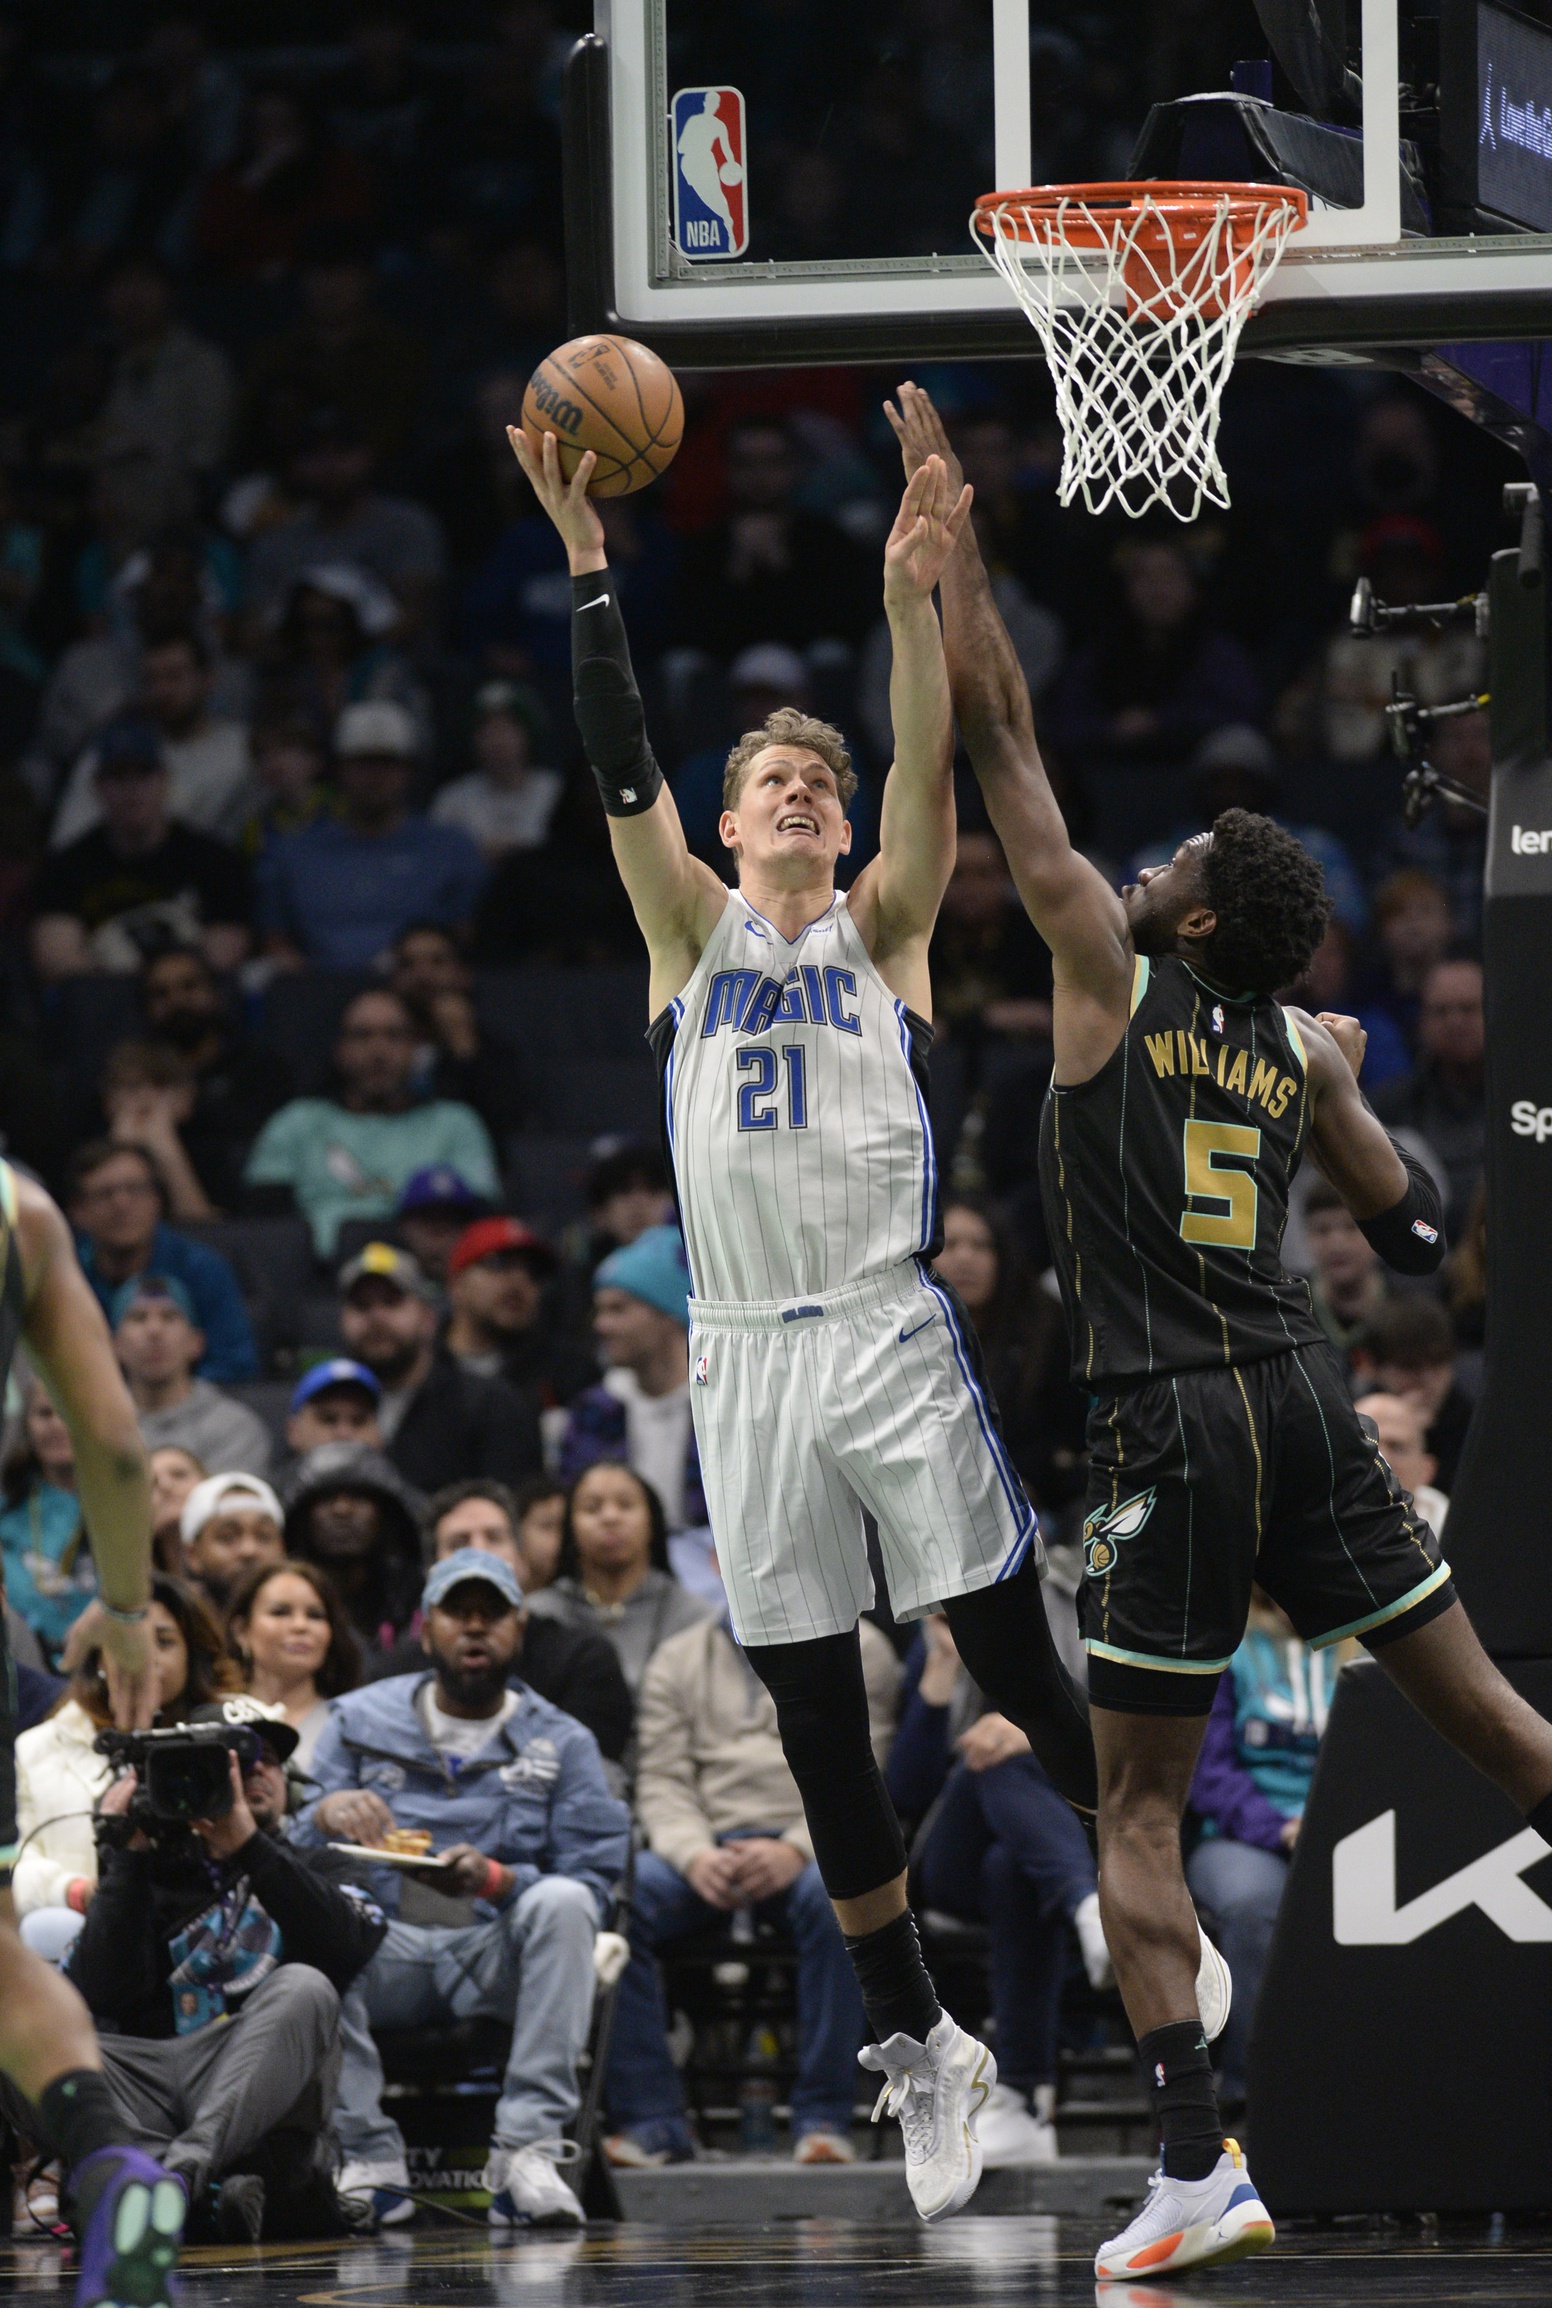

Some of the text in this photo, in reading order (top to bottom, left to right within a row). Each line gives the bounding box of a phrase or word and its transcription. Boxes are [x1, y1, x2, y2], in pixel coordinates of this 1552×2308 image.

[686, 219, 721, 248] NBA
[700, 964, 863, 1039] MAGIC
[736, 1044, 808, 1132] 21
[1511, 1100, 1552, 1143] Sp
[1179, 1118, 1261, 1250] 5
